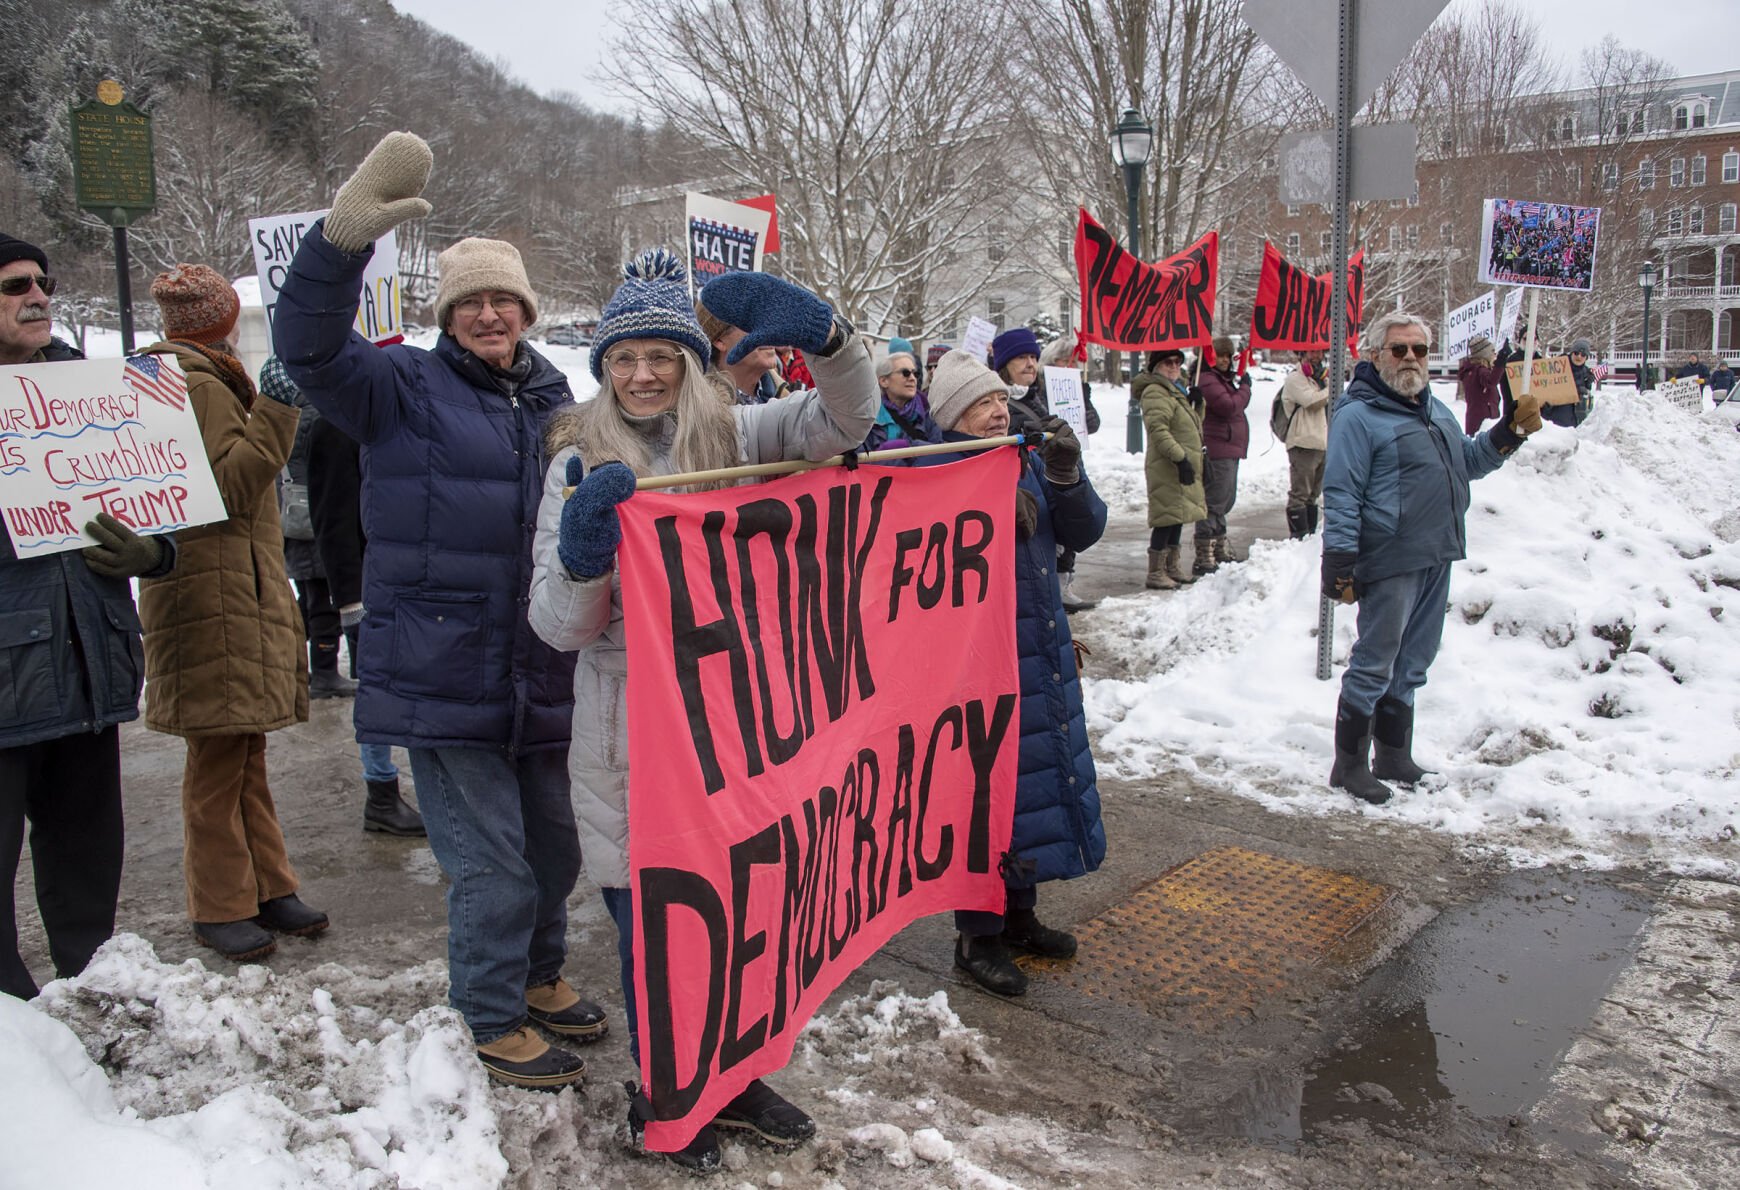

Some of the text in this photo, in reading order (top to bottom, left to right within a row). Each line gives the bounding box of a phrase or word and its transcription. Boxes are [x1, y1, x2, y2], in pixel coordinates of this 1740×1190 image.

[79, 113, 145, 125] STATE HOUSE
[693, 230, 752, 271] HATE
[1450, 298, 1491, 328] COURAGE
[1468, 320, 1477, 333] IS
[1449, 326, 1494, 357] CONTUS!
[1506, 358, 1567, 380] DEMCRACY
[0, 408, 31, 433] UR
[7, 485, 188, 537] UNDER TRUMP
[654, 475, 995, 796] HONK FOR
[640, 693, 1017, 1122] DEMOCRACY
